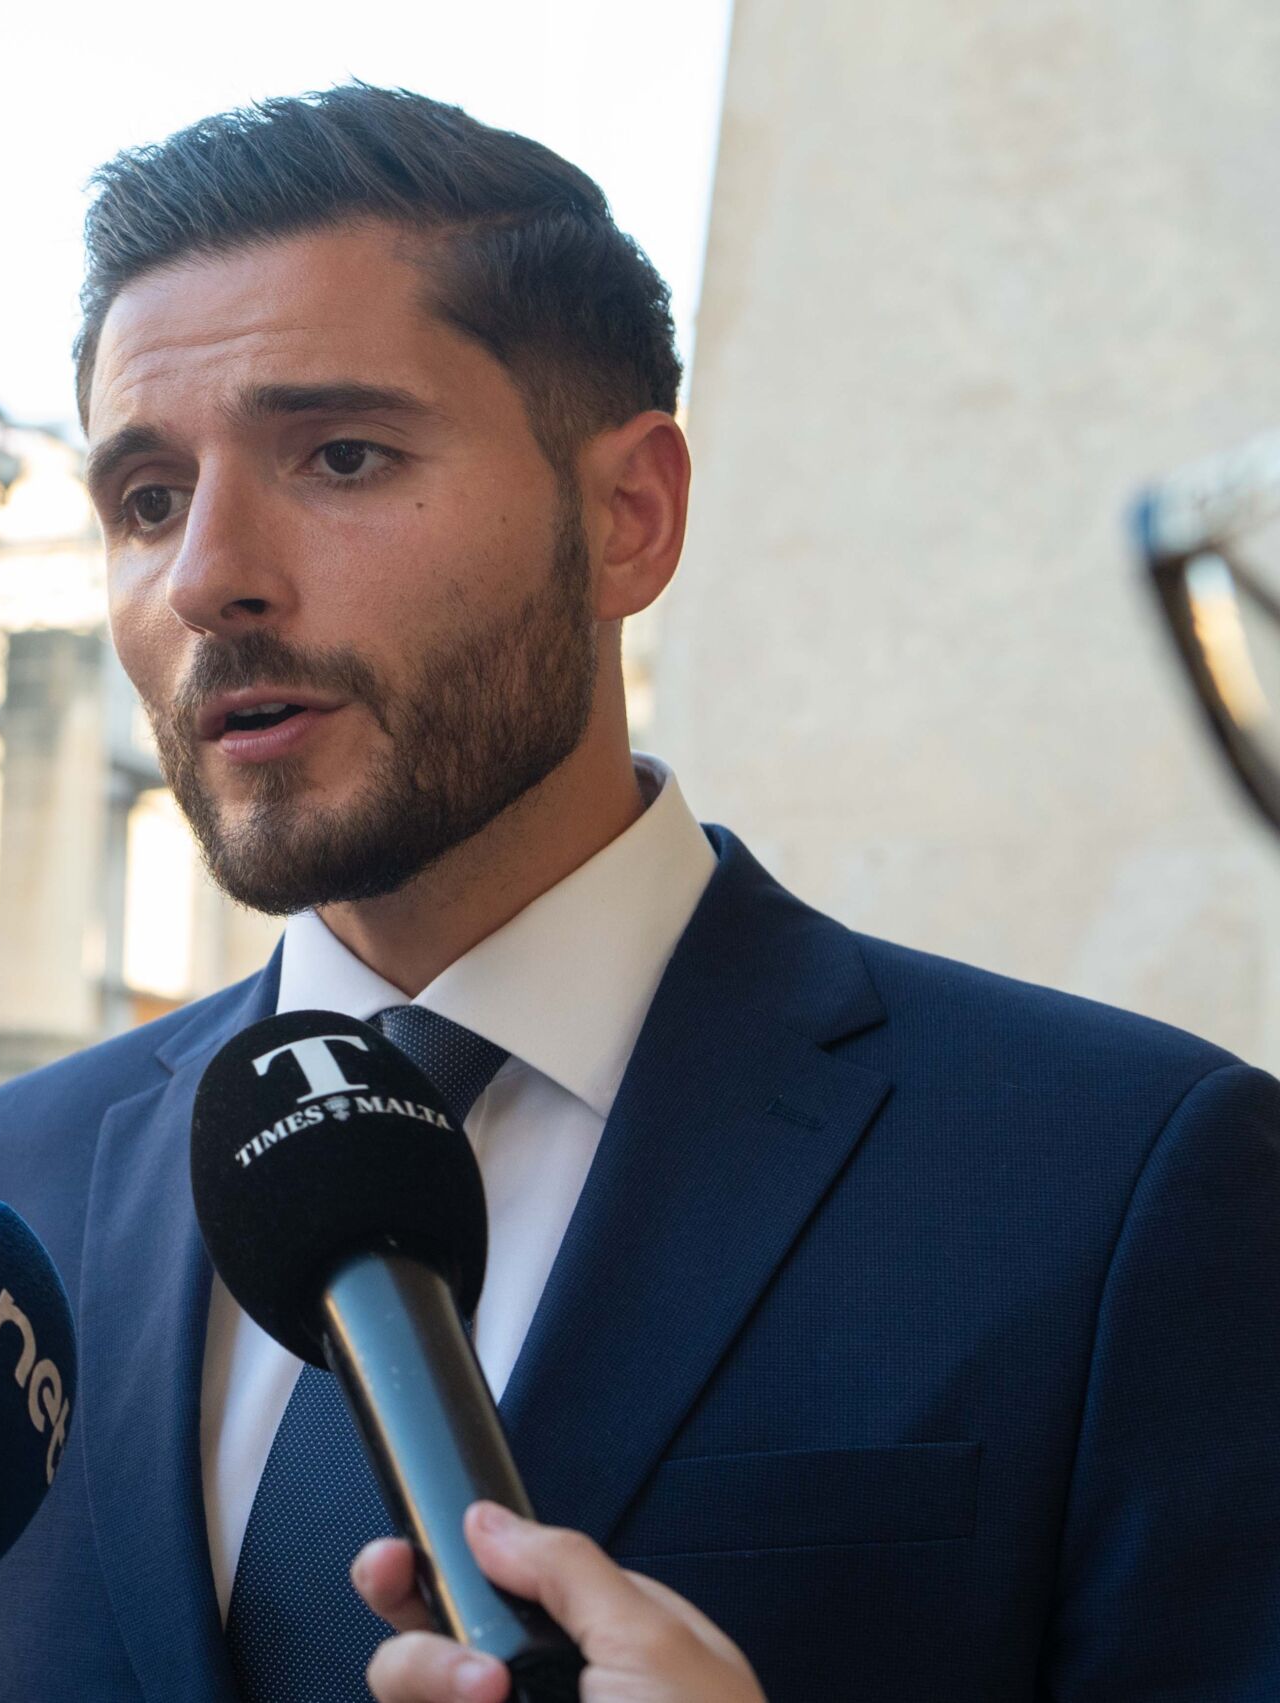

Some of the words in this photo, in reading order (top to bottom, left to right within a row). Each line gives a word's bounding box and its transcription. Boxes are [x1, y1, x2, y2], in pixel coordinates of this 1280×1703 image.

[252, 1035, 370, 1104] T
[234, 1104, 324, 1168] TIMES
[354, 1096, 454, 1132] MALTA
